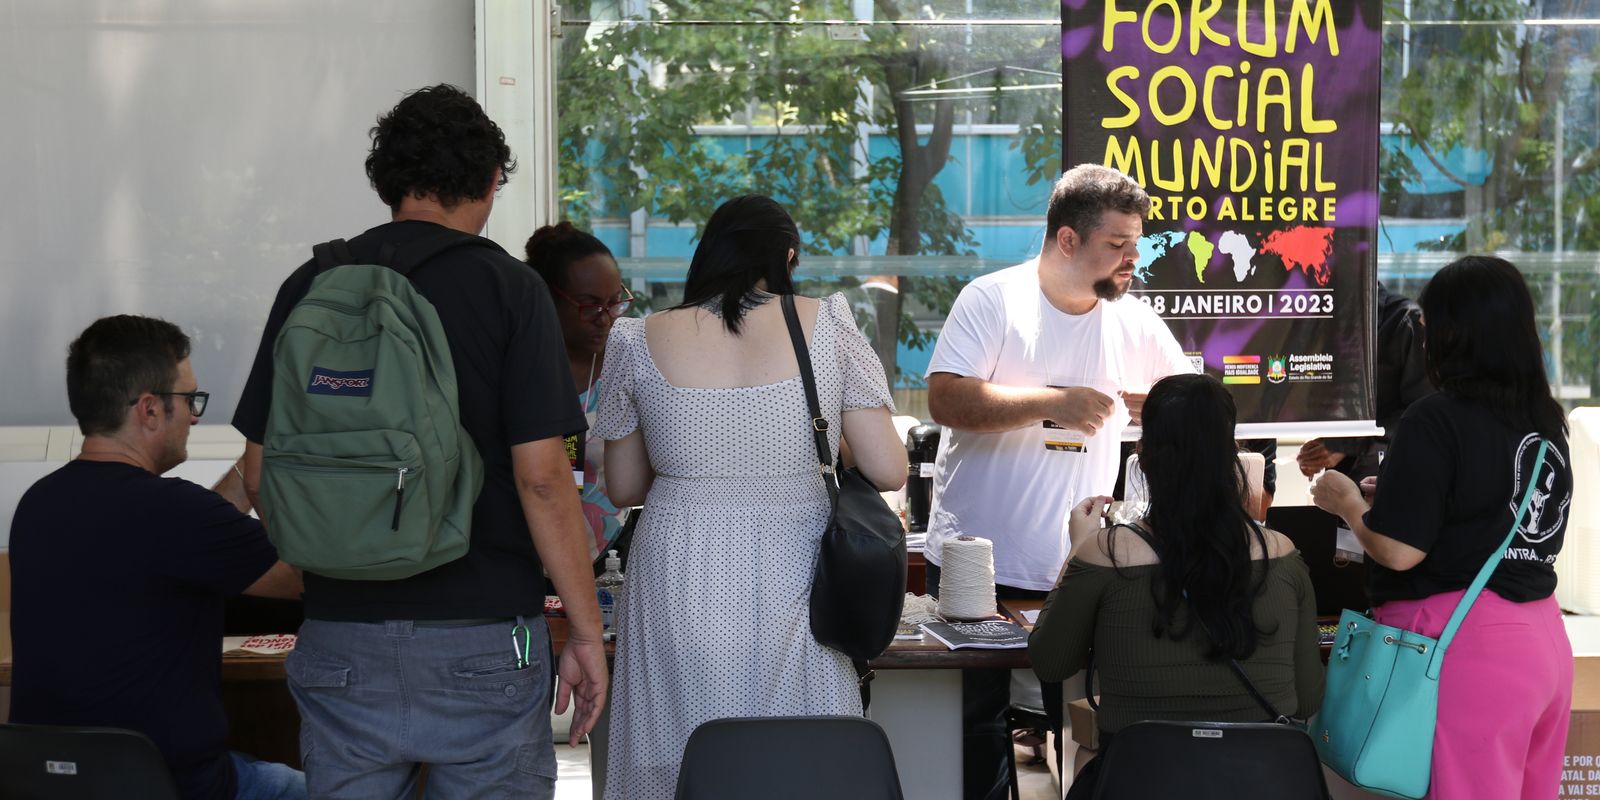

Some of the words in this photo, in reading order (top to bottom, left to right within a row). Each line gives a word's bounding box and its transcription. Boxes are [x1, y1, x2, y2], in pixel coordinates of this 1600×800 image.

[1102, 0, 1340, 58] FORUM
[1148, 196, 1208, 221] RTO
[1217, 196, 1336, 221] ALEGRE
[1171, 295, 1263, 314] JANEIRO
[1280, 294, 1334, 313] 2023
[1289, 353, 1334, 362] Assembleia
[1290, 362, 1331, 372] Legislativa
[1573, 755, 1593, 767] POR
[1568, 784, 1584, 796] VAI
[1586, 784, 1600, 796] SE
